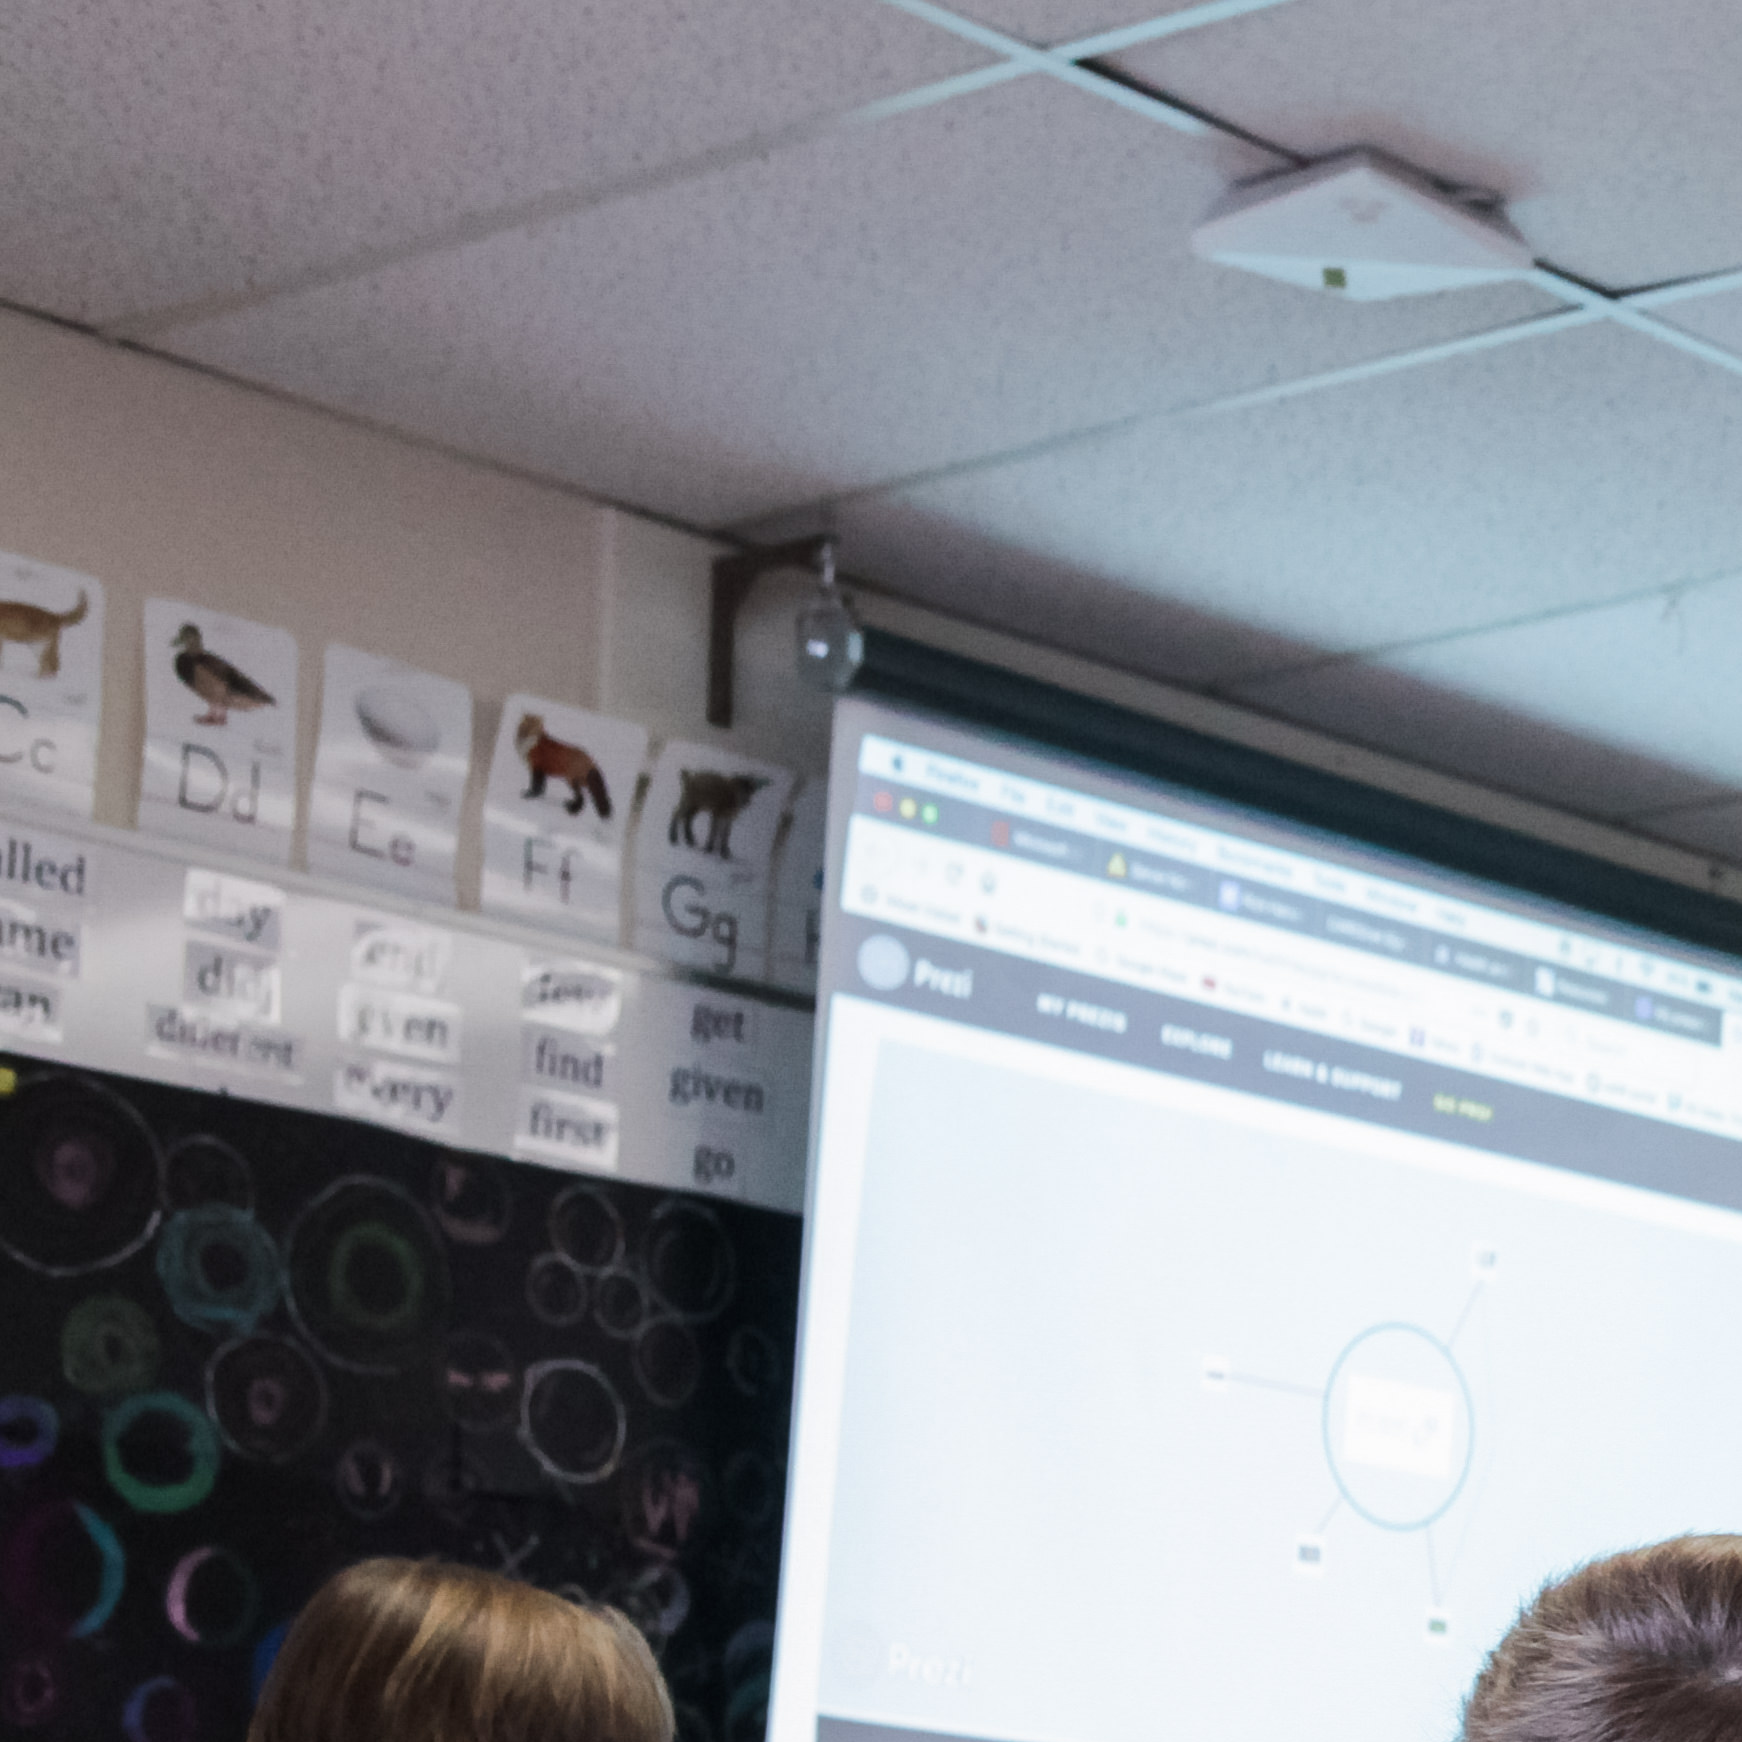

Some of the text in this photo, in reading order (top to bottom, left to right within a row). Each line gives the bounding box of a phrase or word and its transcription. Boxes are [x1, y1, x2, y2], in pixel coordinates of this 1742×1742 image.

[178, 743, 261, 824] Dd
[350, 787, 416, 868] Ee
[0, 838, 87, 896] lled
[524, 836, 584, 904] Ff
[661, 873, 738, 976] Gg
[690, 1004, 745, 1044] get
[536, 1035, 603, 1088] find
[670, 1066, 764, 1114] given
[694, 1145, 734, 1185] go
[889, 1645, 972, 1689] Prezi
